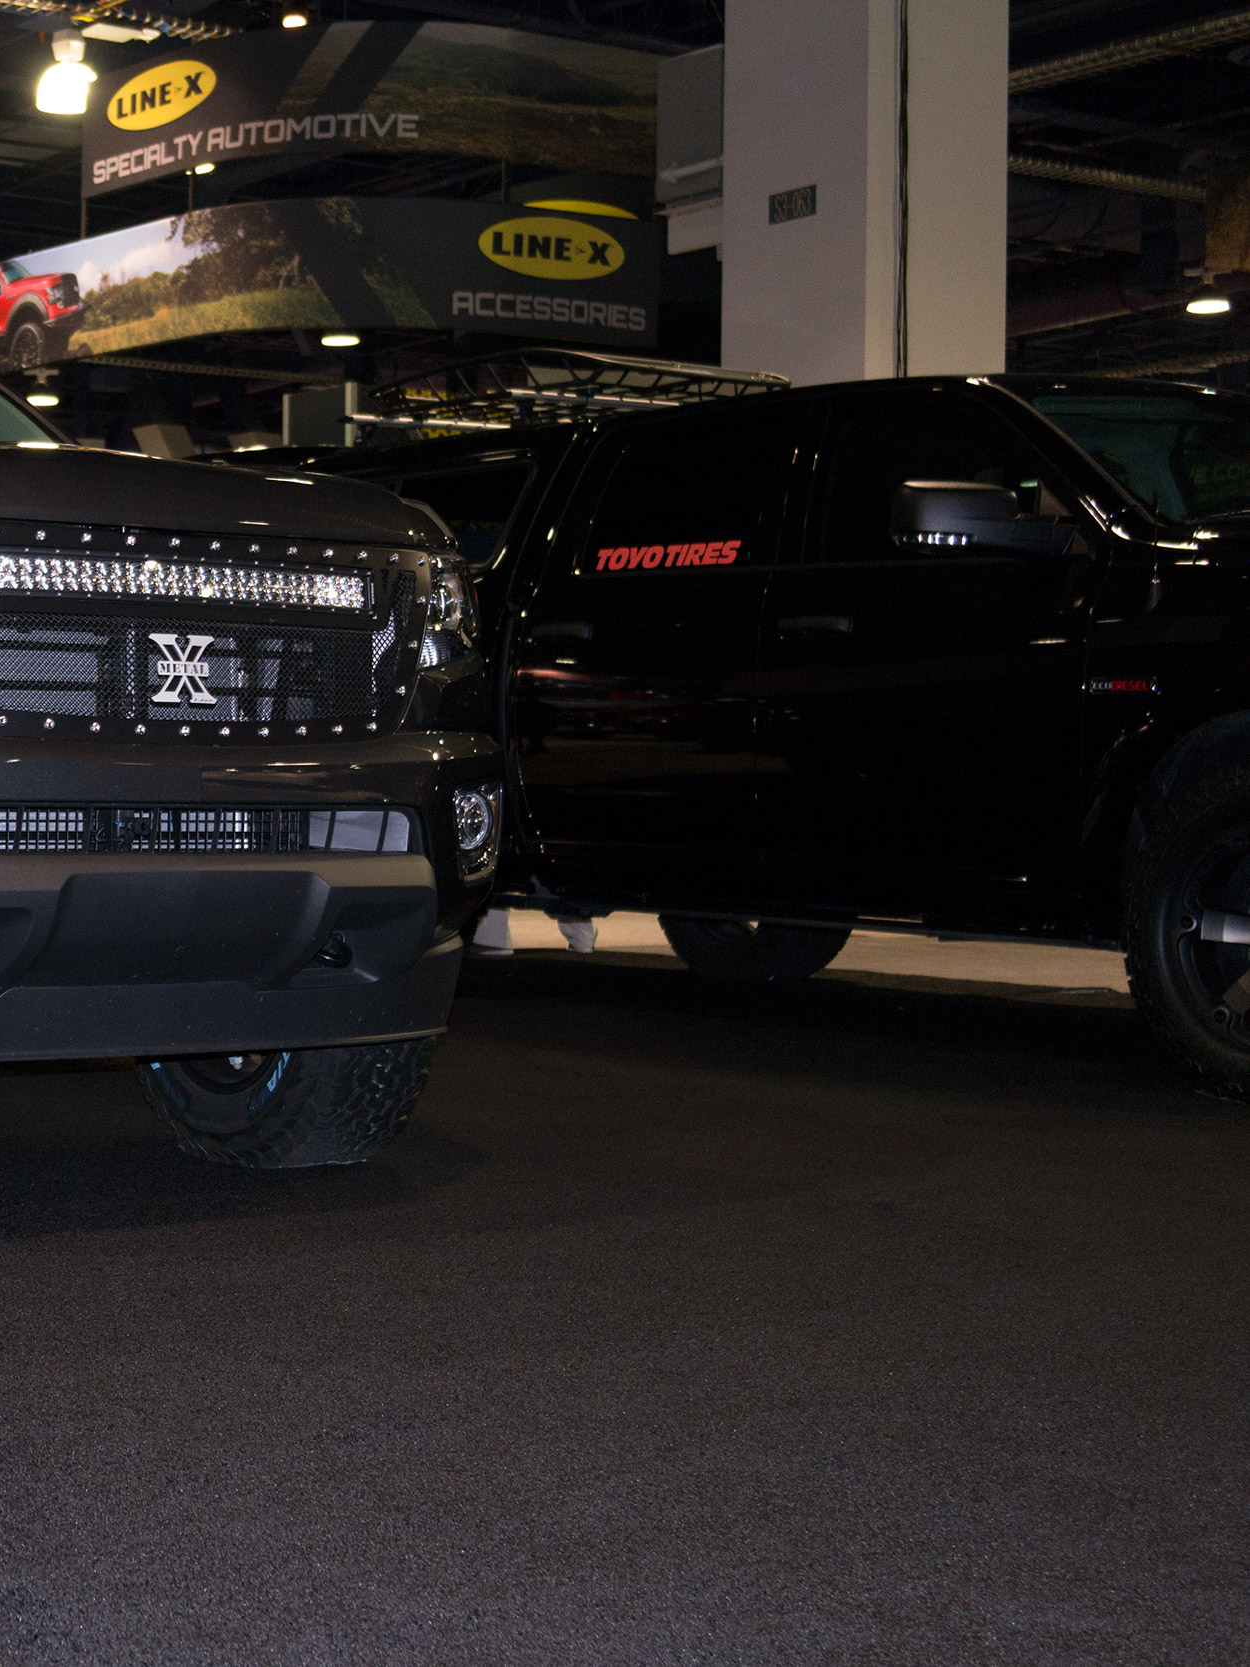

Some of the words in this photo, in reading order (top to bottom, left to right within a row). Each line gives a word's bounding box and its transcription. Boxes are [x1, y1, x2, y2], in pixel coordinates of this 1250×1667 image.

[92, 131, 204, 185] SPECIALTY
[207, 113, 420, 152] AUTOMOTIVE
[452, 291, 647, 332] ACCESSORIES
[159, 662, 208, 675] METAL
